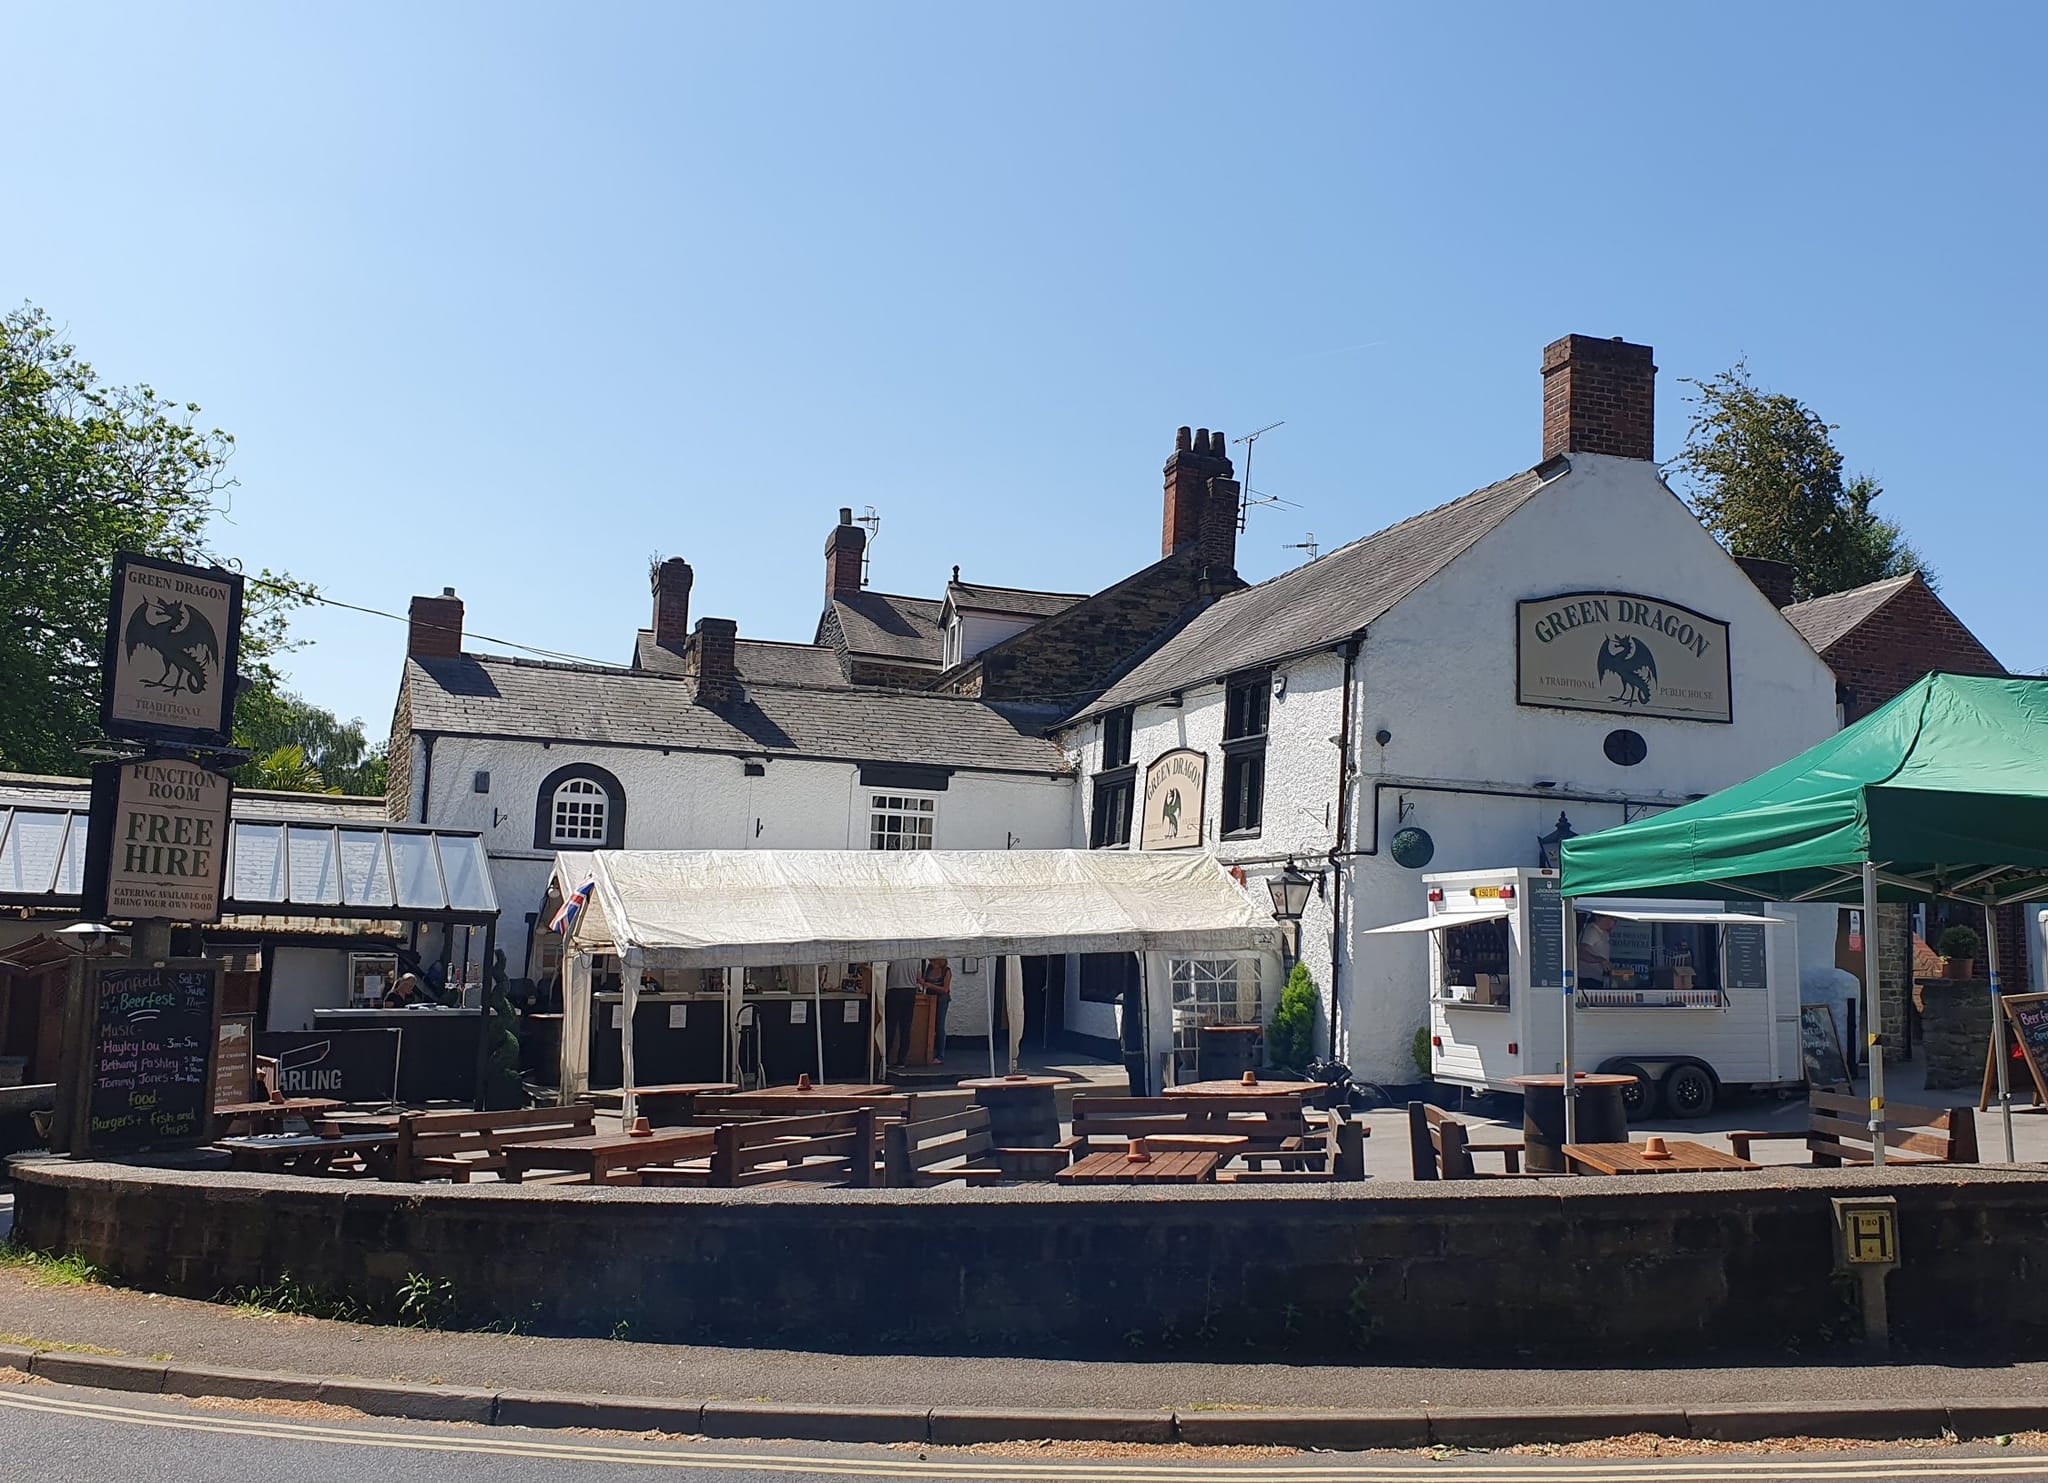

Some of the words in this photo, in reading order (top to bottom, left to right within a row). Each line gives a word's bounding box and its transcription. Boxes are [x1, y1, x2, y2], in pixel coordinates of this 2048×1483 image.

[128, 571, 172, 590] GREEN
[175, 580, 226, 600] DRAGON
[1535, 600, 1609, 643] GREEN
[1618, 600, 1711, 658] DRAGON
[1546, 677, 1595, 689] TRADITIONAL
[1660, 687, 1687, 698] PUBLIC
[1688, 689, 1713, 700] HOUSE
[136, 699, 201, 717] TRADITIONAL
[134, 765, 217, 788] FUNCTION
[1147, 761, 1171, 800] GREEN
[1173, 757, 1201, 792] DRAGON
[149, 782, 200, 801] ROOM
[125, 812, 213, 847] FREE
[123, 844, 210, 877] HIRE
[114, 888, 156, 898] CATERING
[158, 890, 199, 900] AVAILABLE
[201, 893, 213, 902] OR
[114, 897, 141, 907] BRING
[143, 899, 166, 908] YOUR
[168, 900, 187, 909] OWN
[190, 902, 212, 910] FOOD
[120, 992, 176, 1010] Beerfest
[101, 1059, 138, 1072] Bethany
[98, 1077, 136, 1089] Tommy
[138, 1072, 168, 1085] Jones
[279, 1069, 342, 1091] ARLING
[92, 1114, 134, 1132] Burgers
[177, 1106, 197, 1120] and
[1853, 1216, 1887, 1257] H
